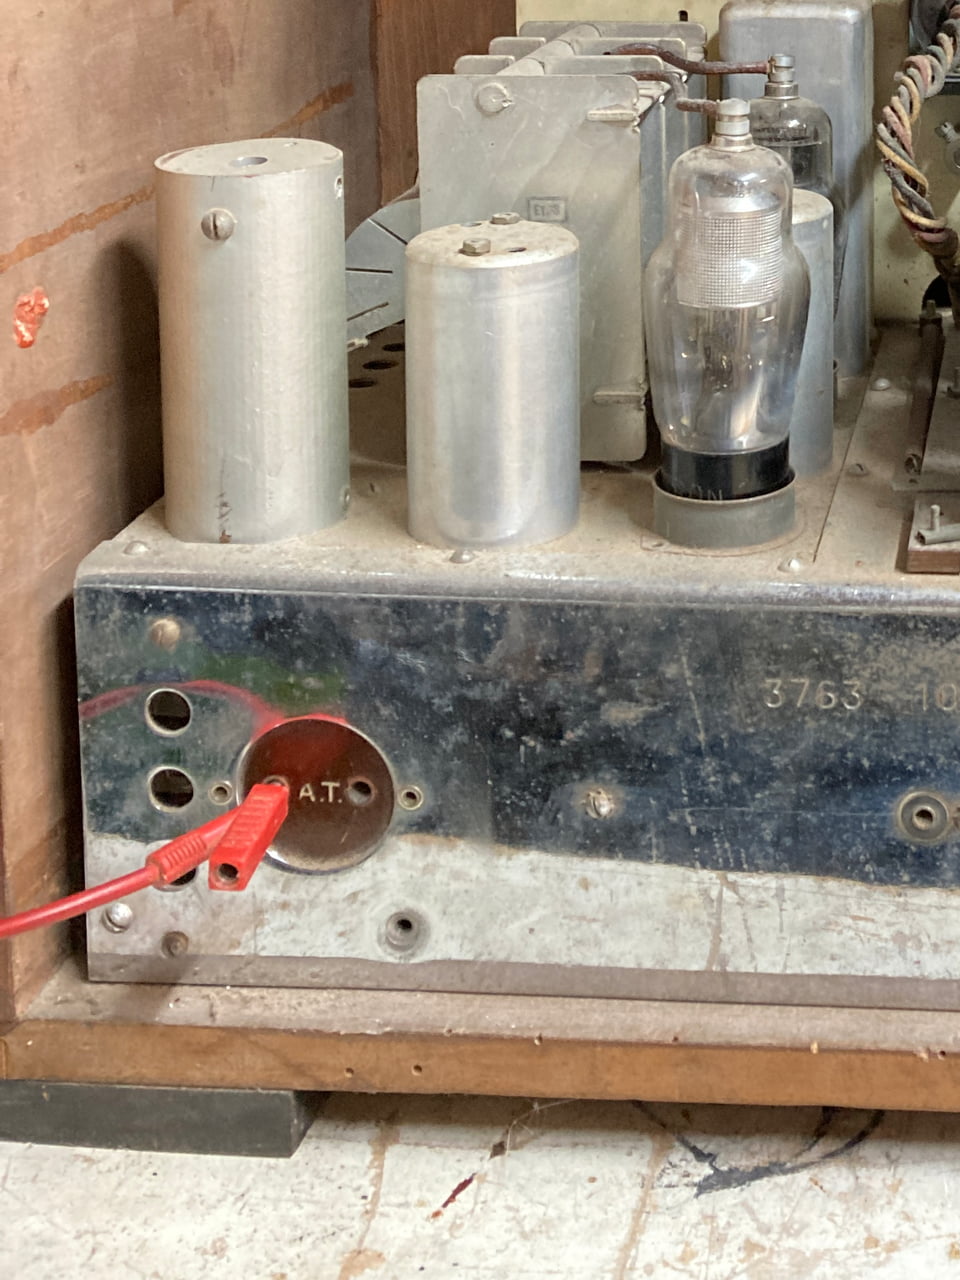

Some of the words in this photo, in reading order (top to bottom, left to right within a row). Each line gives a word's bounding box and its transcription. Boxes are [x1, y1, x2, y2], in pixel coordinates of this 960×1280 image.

[764, 678, 865, 711] 3763
[918, 683, 959, 712] 10
[299, 781, 343, 804] A.T.
